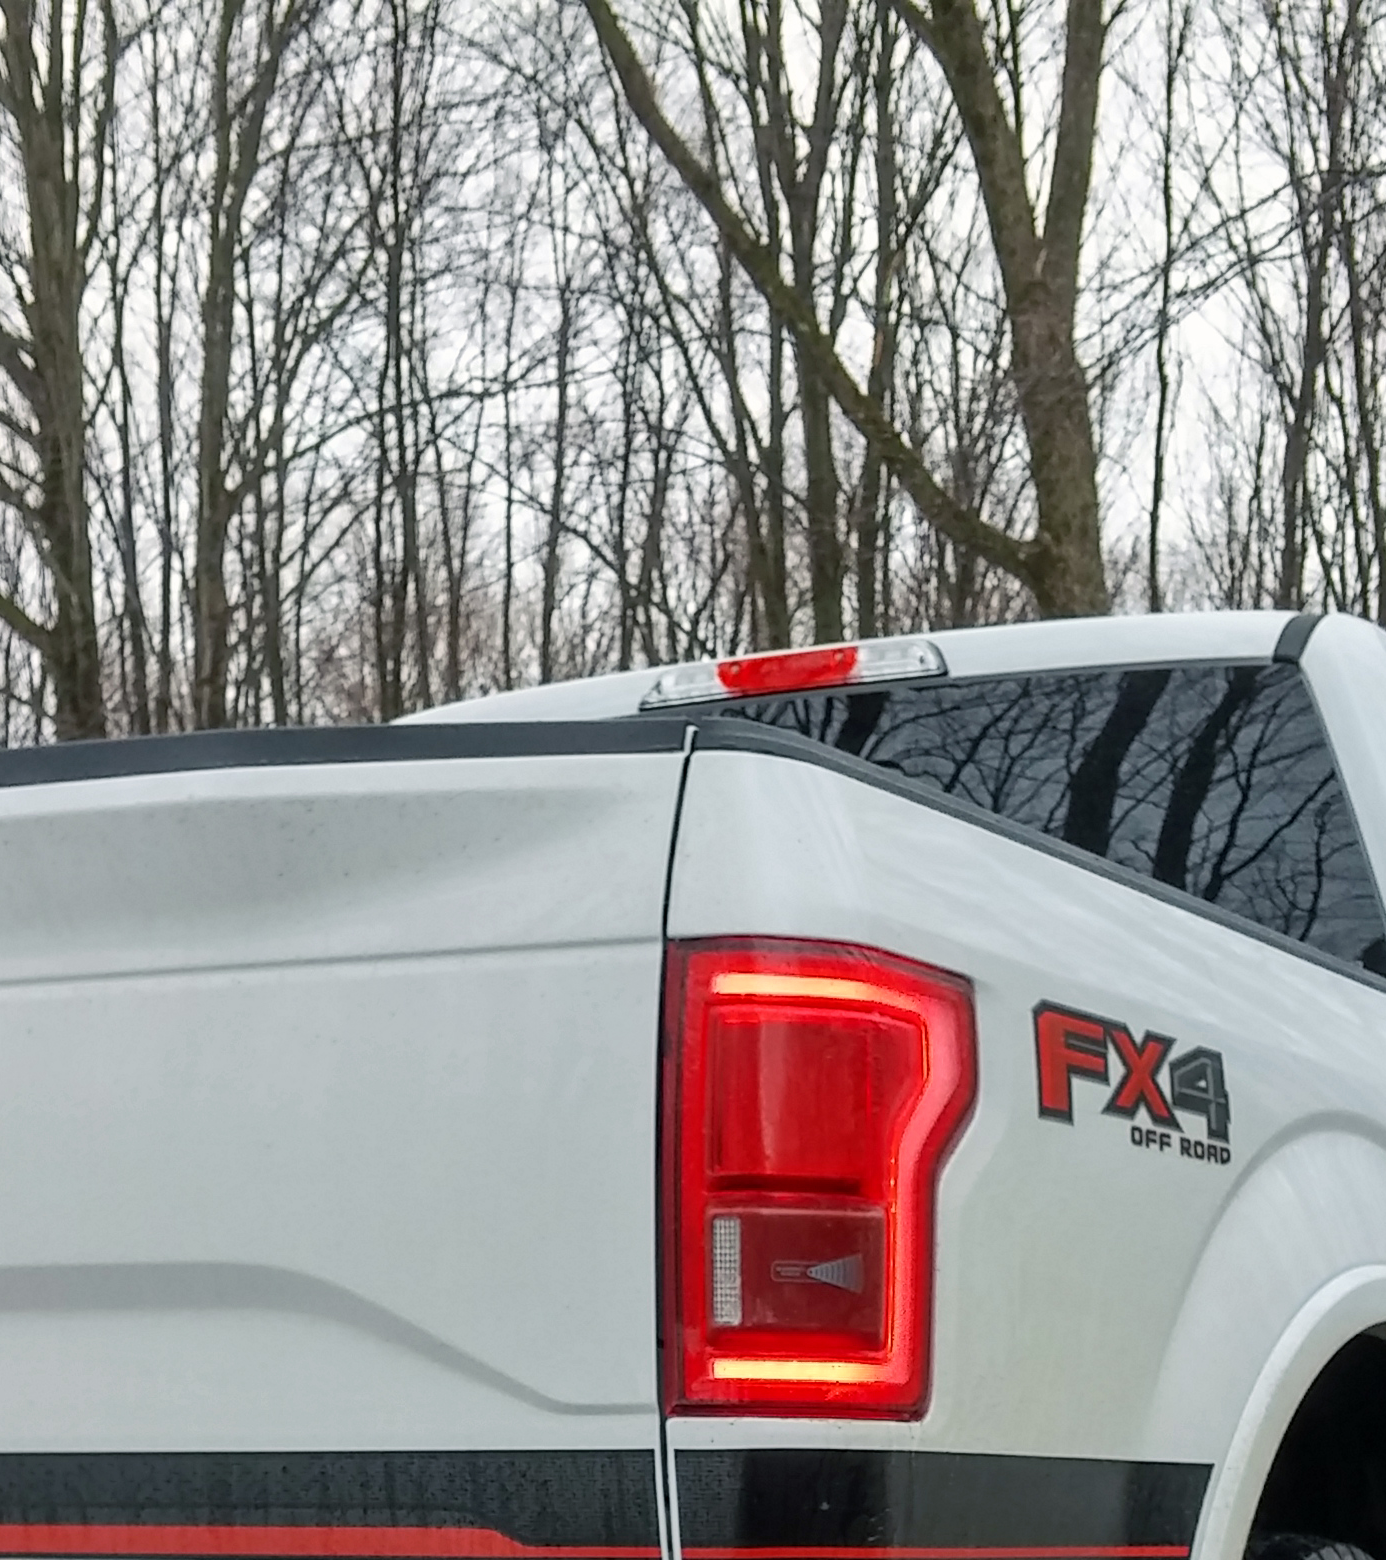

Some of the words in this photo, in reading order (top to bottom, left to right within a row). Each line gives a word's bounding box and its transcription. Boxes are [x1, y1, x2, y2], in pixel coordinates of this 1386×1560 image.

[1031, 998, 1231, 1145] FX4
[1130, 1125, 1172, 1152] OFF
[1179, 1136, 1232, 1165] ROAD
